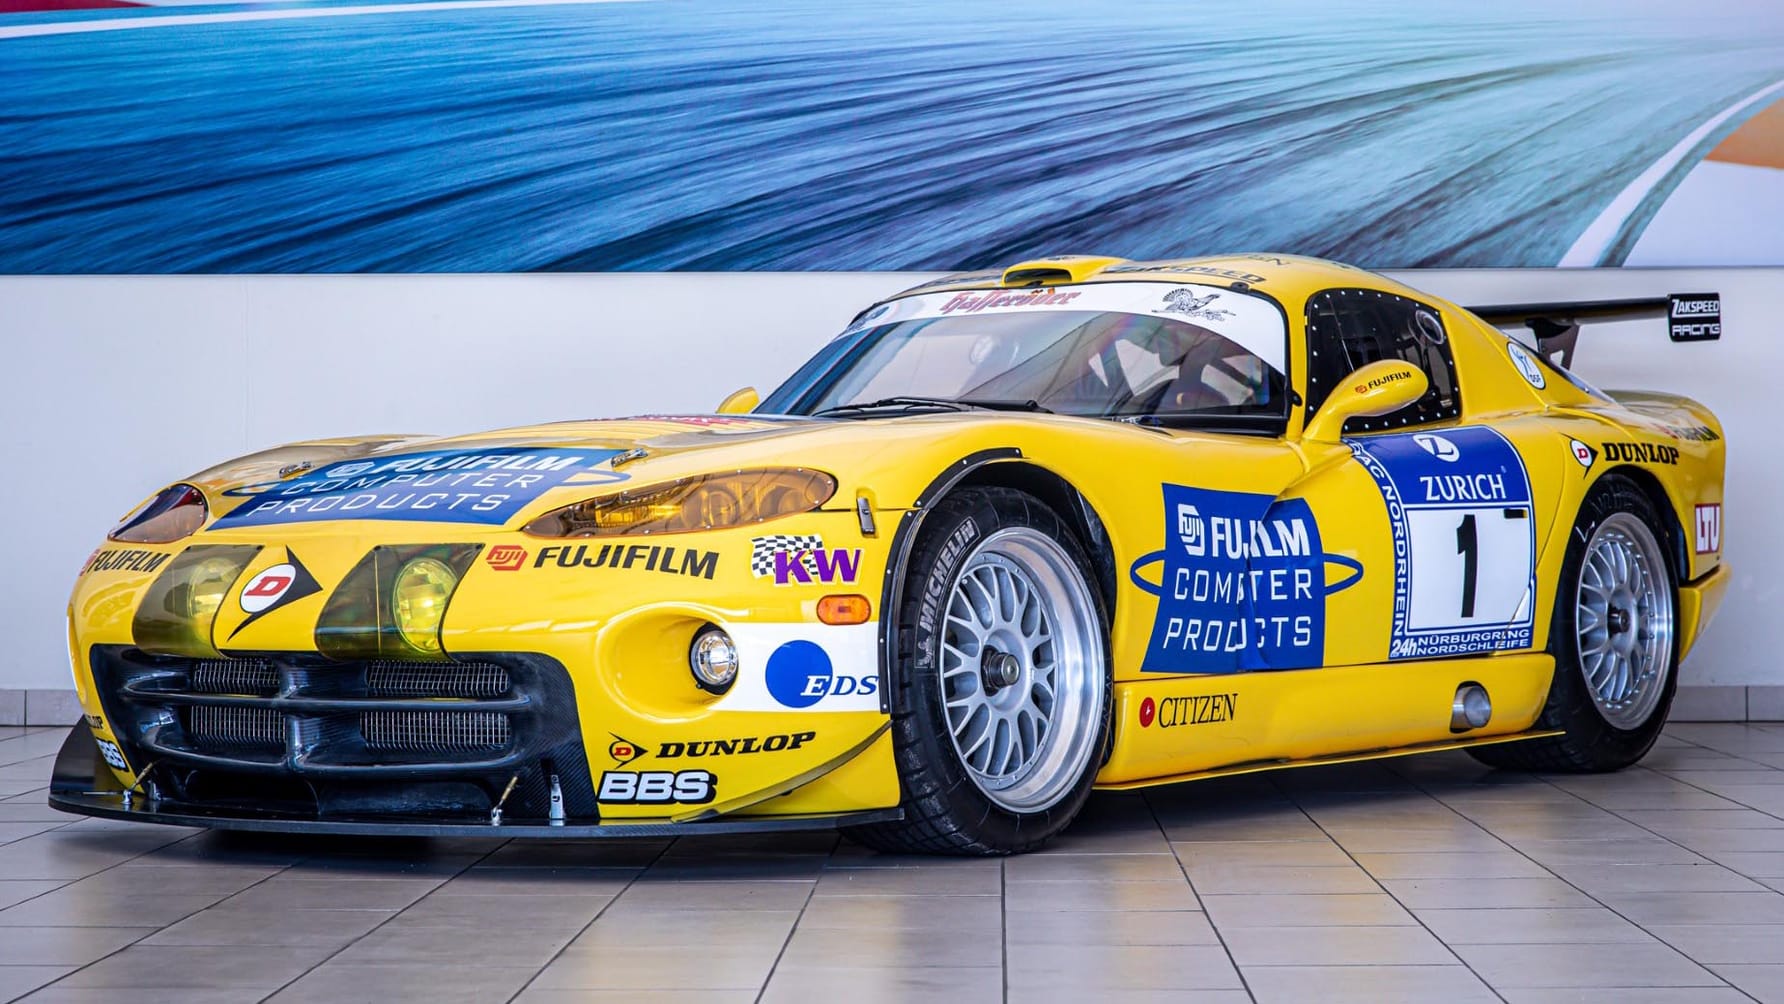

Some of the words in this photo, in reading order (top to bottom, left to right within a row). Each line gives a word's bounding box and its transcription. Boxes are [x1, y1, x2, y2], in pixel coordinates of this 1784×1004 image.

[1672, 299, 1719, 318] ZAKSPEED
[1368, 371, 1412, 389] FUJIFILM
[369, 455, 584, 474] FUJIFILM
[1602, 443, 1680, 465] DUNLOP
[281, 472, 546, 495] COMPUTER
[1420, 474, 1507, 501] ZURICH
[246, 493, 512, 517] PRODUCTS
[1696, 506, 1720, 551] LTU
[87, 550, 171, 573] FUJIFILM
[533, 545, 719, 580] FUJIFILM
[774, 549, 862, 585] KW
[1382, 485, 1407, 636] NORDRHEIN
[1457, 514, 1479, 618] 1
[244, 576, 292, 597] D
[919, 520, 977, 632] MICHELIN
[1174, 567, 1312, 605] COMTER
[1391, 638, 1417, 657] 24h
[1416, 638, 1529, 656] NORDSCHLEIFE
[1418, 629, 1530, 646] NÜRBURGRING
[800, 675, 878, 697] EDS
[1158, 693, 1238, 728] CITIZEN
[655, 731, 816, 758] DUNLOP
[598, 770, 717, 803] BBS
